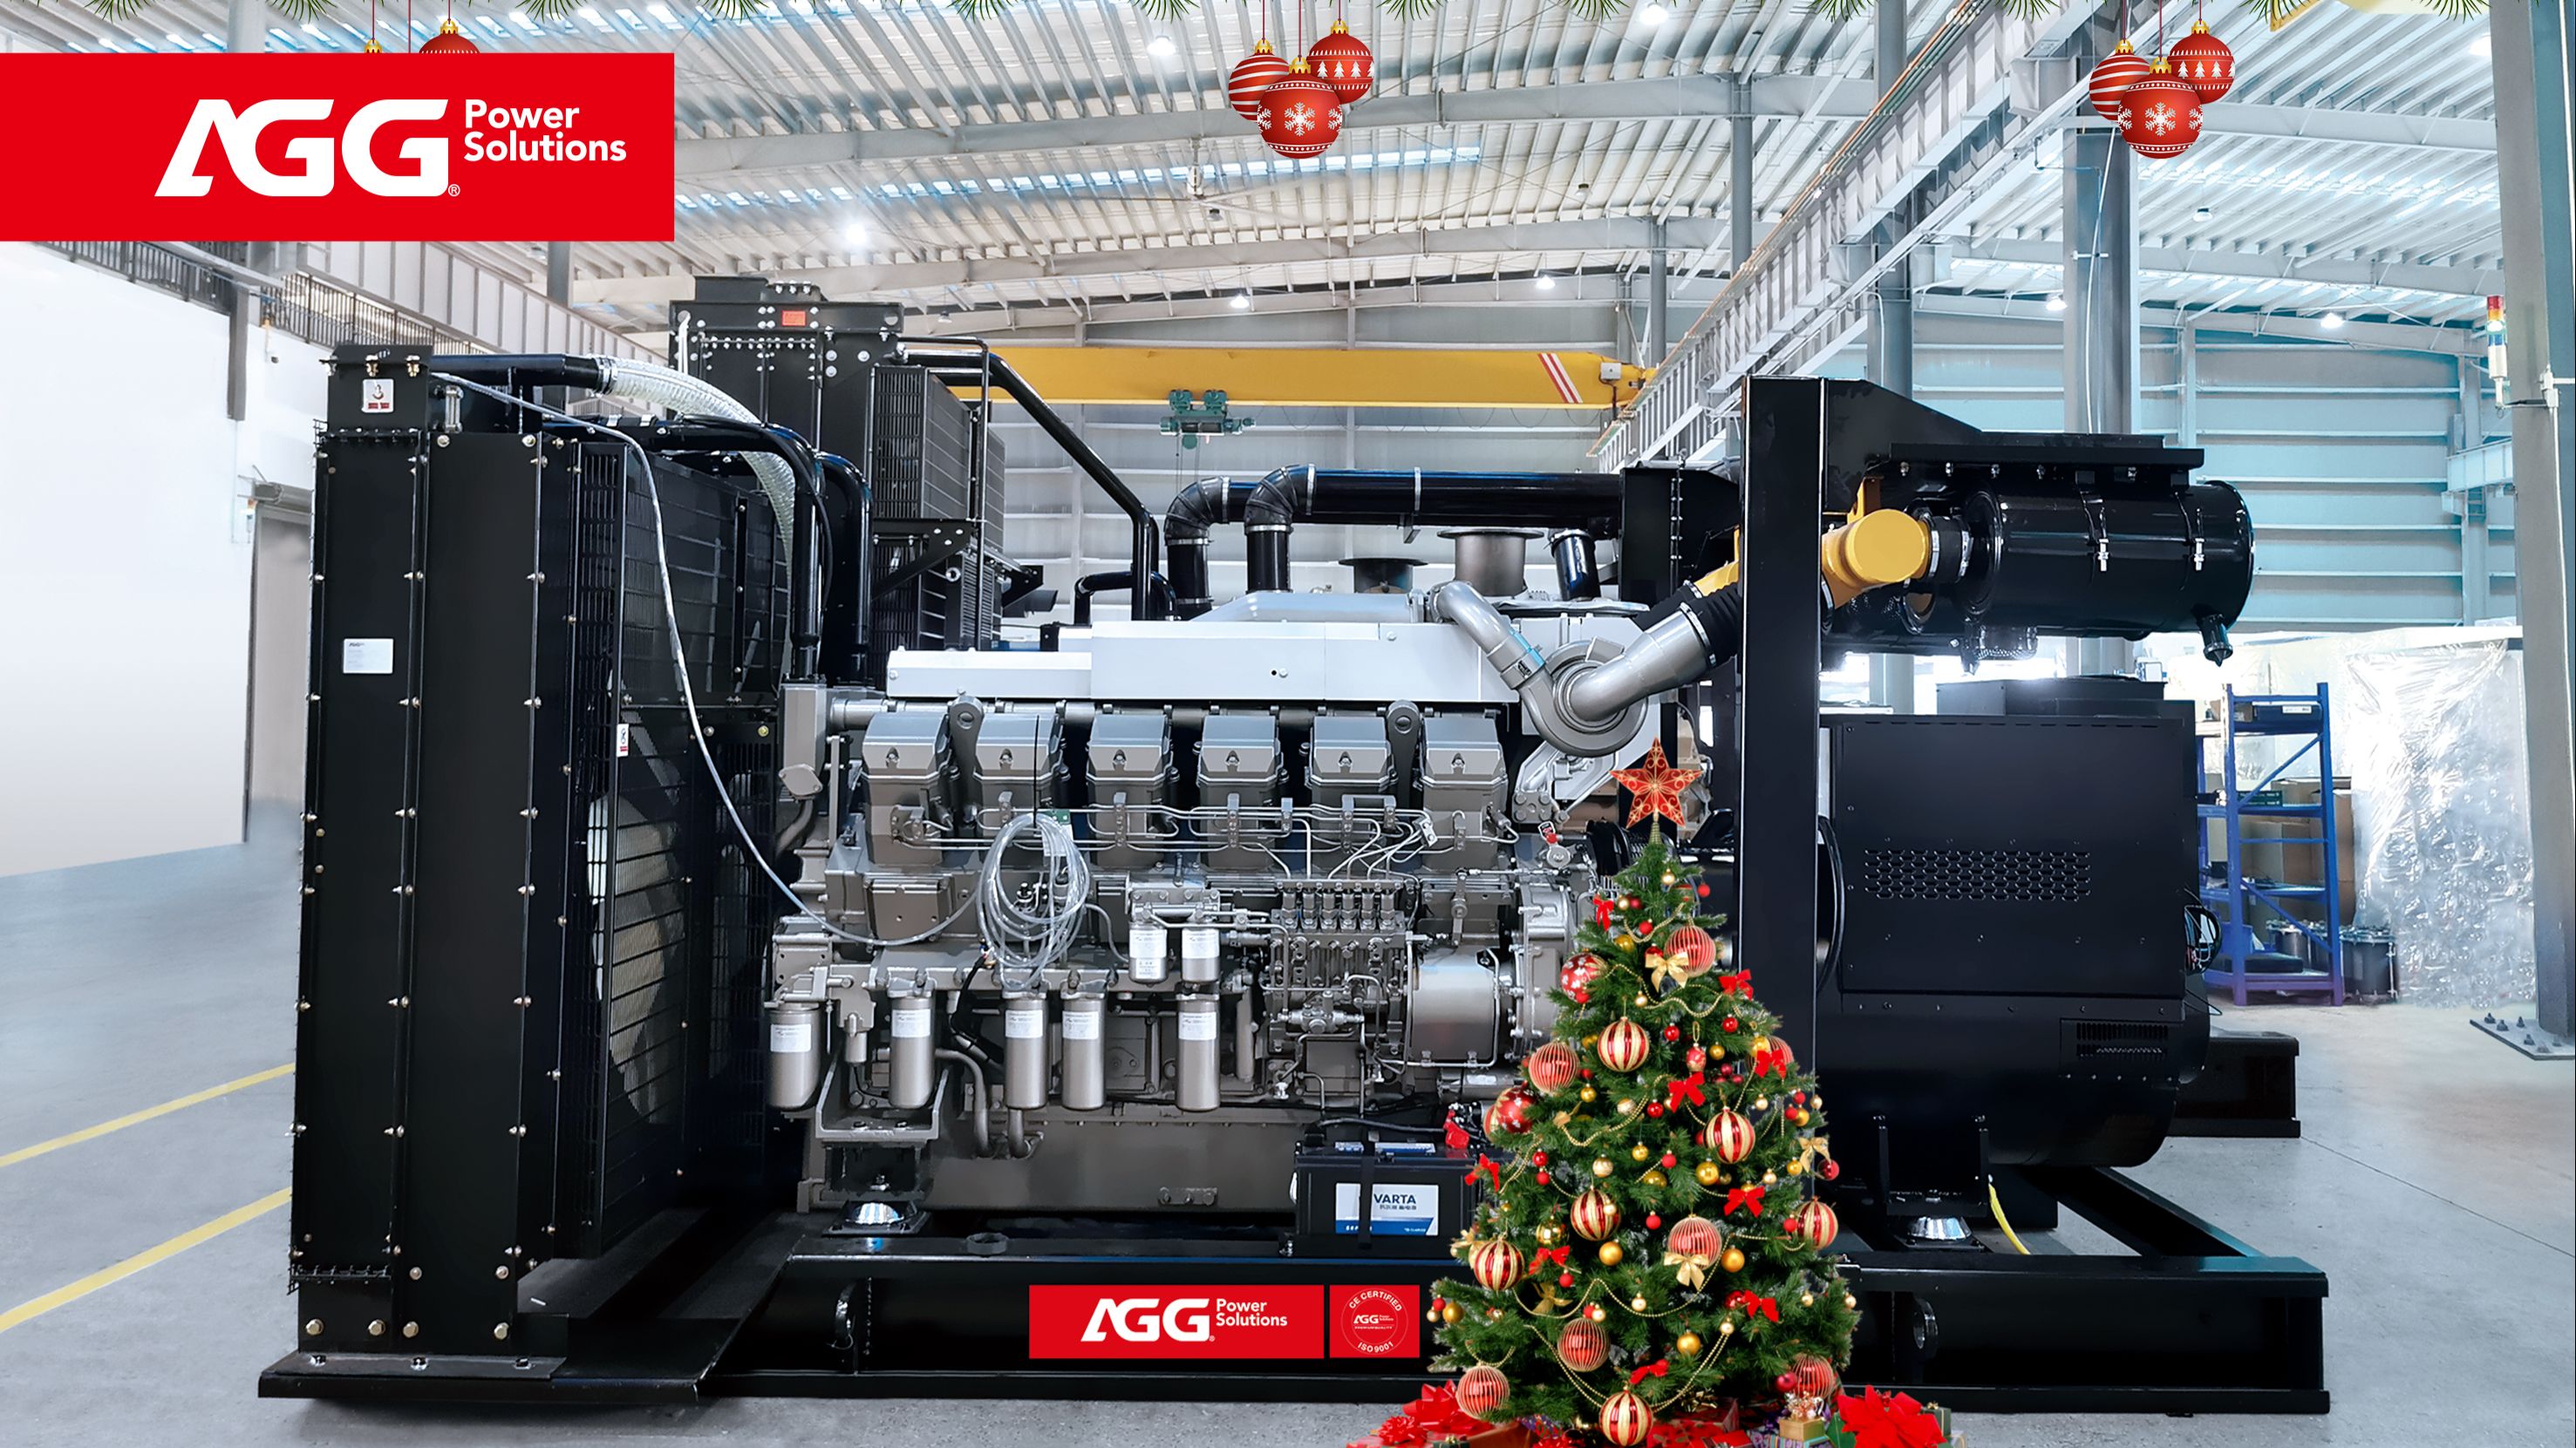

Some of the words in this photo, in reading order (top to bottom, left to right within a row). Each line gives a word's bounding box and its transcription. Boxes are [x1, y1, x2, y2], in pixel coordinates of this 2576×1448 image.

[1373, 1193, 1416, 1205] VARTA
[1216, 1298, 1268, 1312] Power
[1349, 1296, 1361, 1309] CE
[1360, 1290, 1402, 1311] CERTIFIED
[1216, 1311, 1288, 1326] Solutions
[1353, 1315, 1379, 1323] AGG
